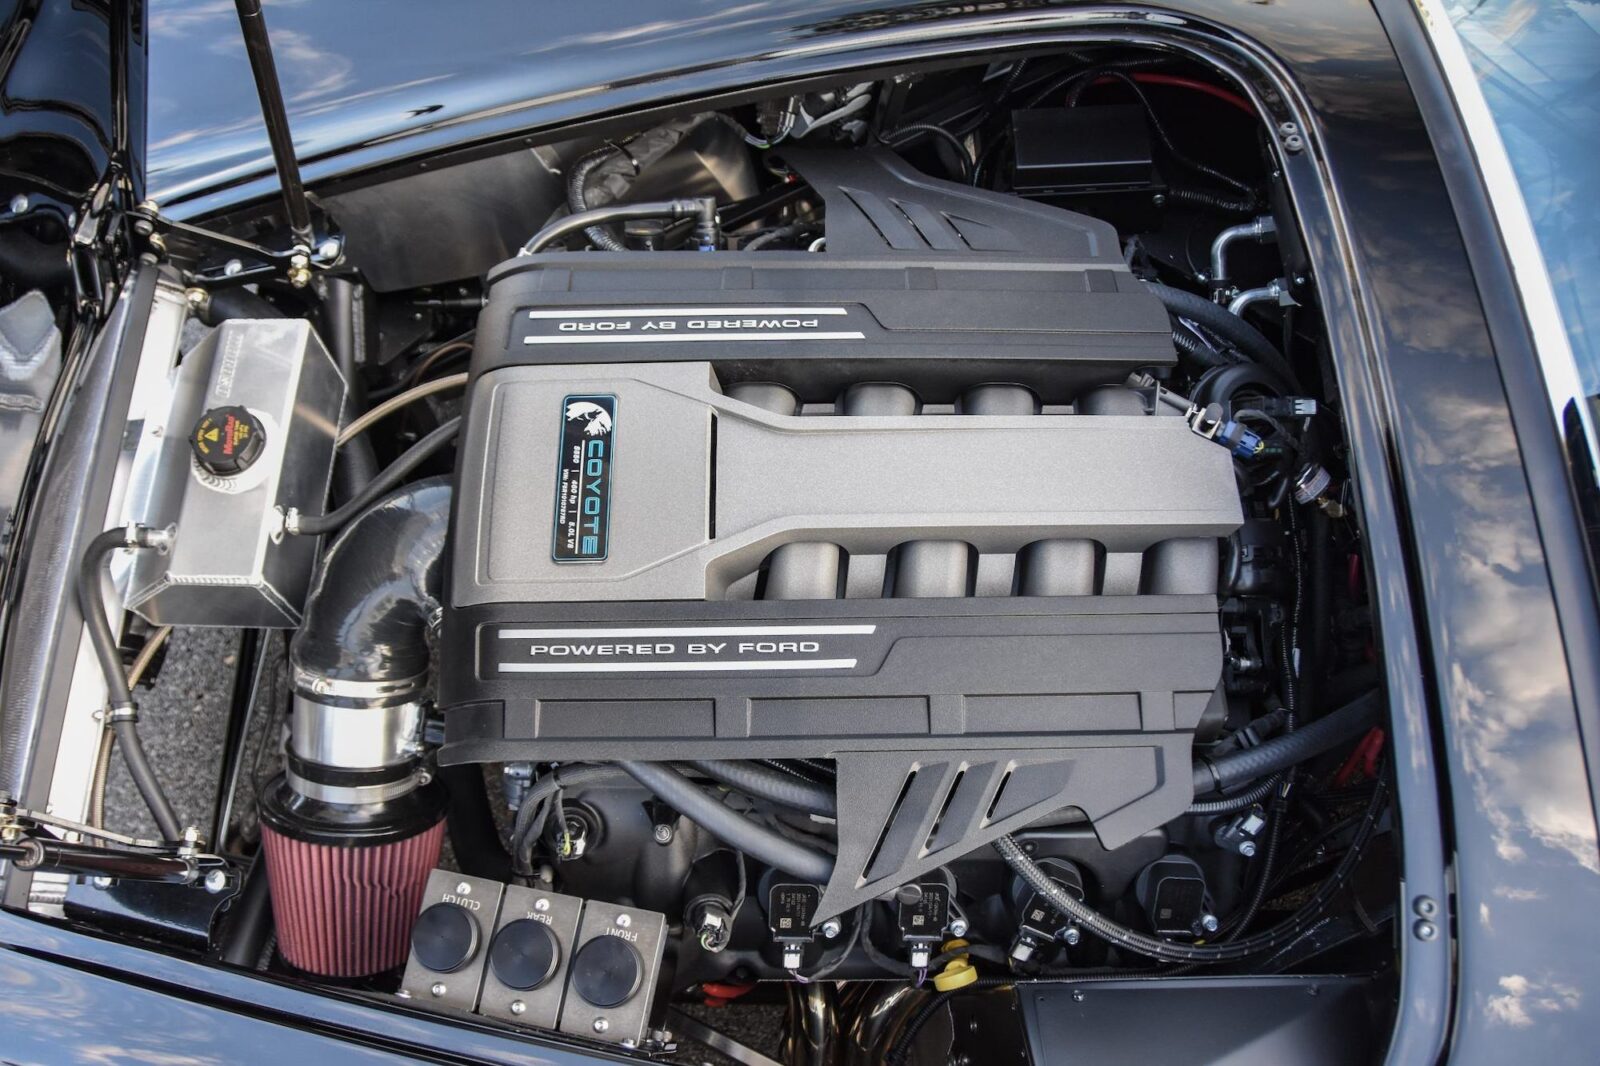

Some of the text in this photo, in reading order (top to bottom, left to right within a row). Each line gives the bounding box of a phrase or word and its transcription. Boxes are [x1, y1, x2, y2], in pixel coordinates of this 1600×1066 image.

[559, 319, 819, 331] POWERED BY FORD
[568, 494, 577, 504] hp
[581, 440, 604, 555] COYOTE
[530, 641, 820, 656] POWERED BY FORD
[442, 893, 481, 911] CLUTCH
[604, 927, 638, 942] FRONT
